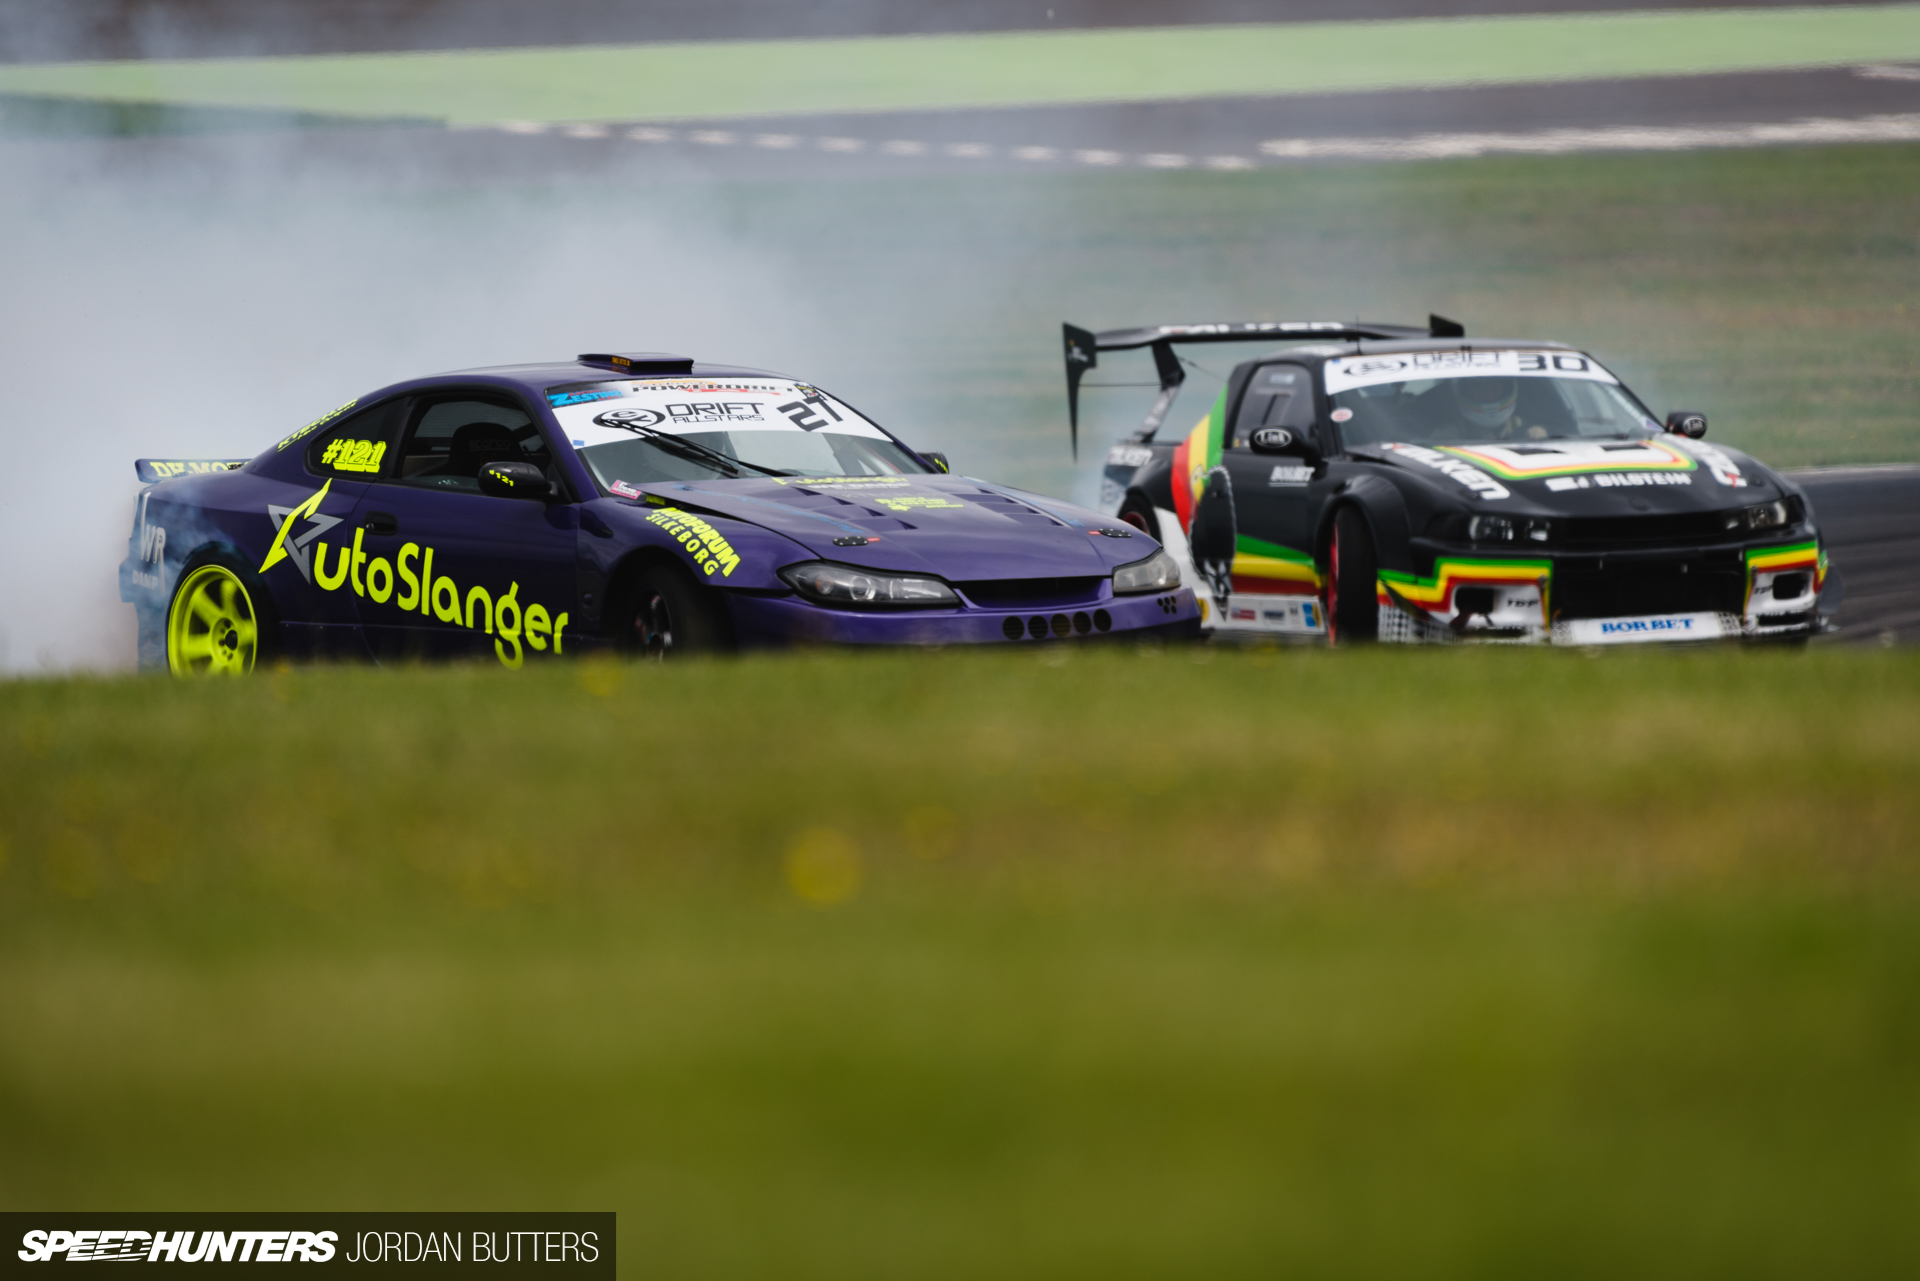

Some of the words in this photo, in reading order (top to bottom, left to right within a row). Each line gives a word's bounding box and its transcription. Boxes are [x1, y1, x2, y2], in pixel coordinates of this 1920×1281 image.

[1517, 353, 1589, 372] 30
[665, 402, 765, 417] DRIFT
[321, 438, 387, 473] #121
[646, 513, 719, 576] SILKEBORG
[652, 507, 741, 577] AUTOFORUM
